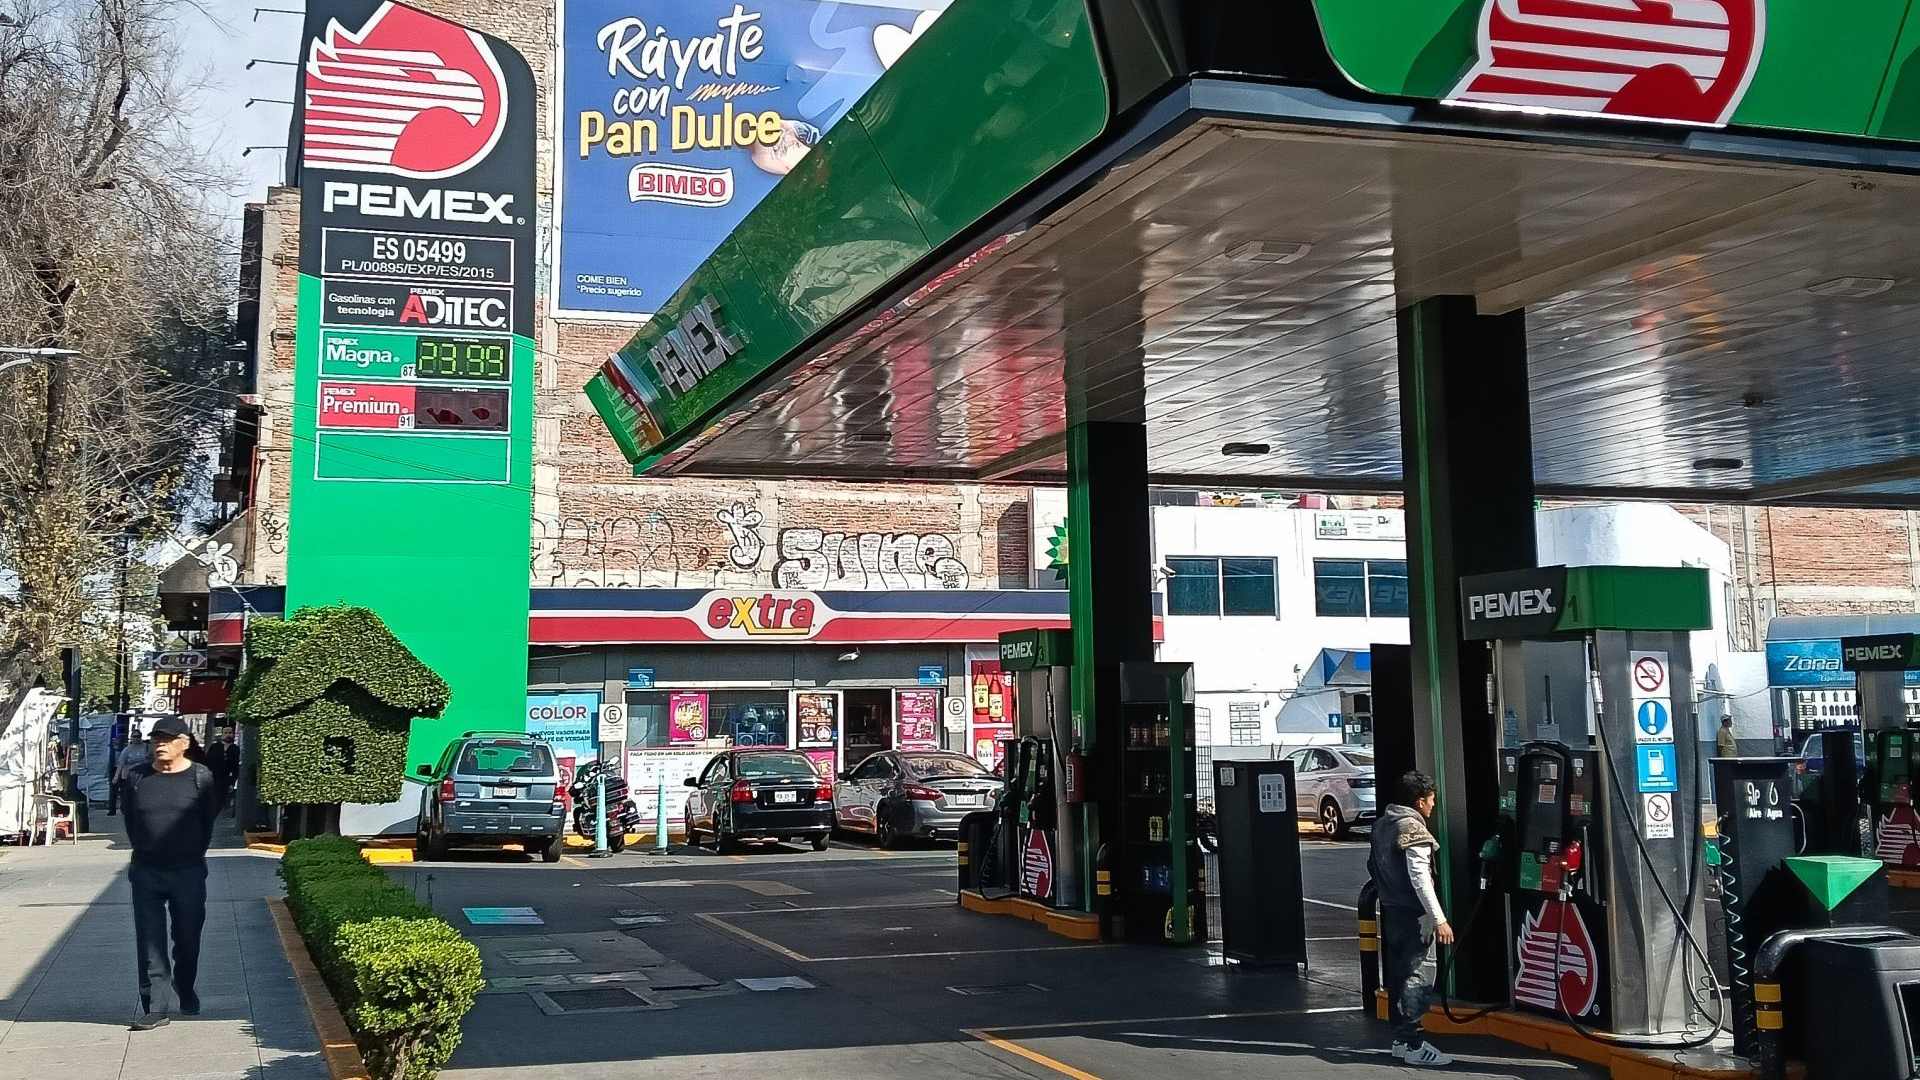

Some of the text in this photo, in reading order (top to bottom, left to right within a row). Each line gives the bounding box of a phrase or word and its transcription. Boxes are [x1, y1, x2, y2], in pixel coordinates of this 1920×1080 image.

[597, 4, 765, 90] Ráyate
[613, 85, 669, 118] con
[579, 103, 783, 161] Pan Dulce
[638, 172, 727, 198] BIMBO
[323, 181, 513, 224] PEMEX
[373, 237, 466, 264] ES 05499
[341, 259, 495, 279] PL/00895/EXP/ES/2015
[577, 275, 627, 286] COME BIEN
[329, 293, 396, 305] Gasolinas con
[410, 287, 444, 296] PEMEX
[607, 288, 642, 298] sugerido
[650, 294, 745, 400] PEMEX
[326, 346, 392, 368] Magna
[419, 342, 504, 377] 23.99
[403, 367, 413, 377] 87
[322, 396, 399, 415] Premium
[400, 416, 411, 427] 91
[707, 592, 815, 635] extra
[1468, 588, 1552, 620] PEMEX
[1001, 641, 1033, 660] PEMEX
[1845, 645, 1902, 661] PEMEX
[1783, 655, 1840, 671] Zona
[529, 706, 587, 720] COLOR
[1749, 807, 1783, 820] Aire Agua
